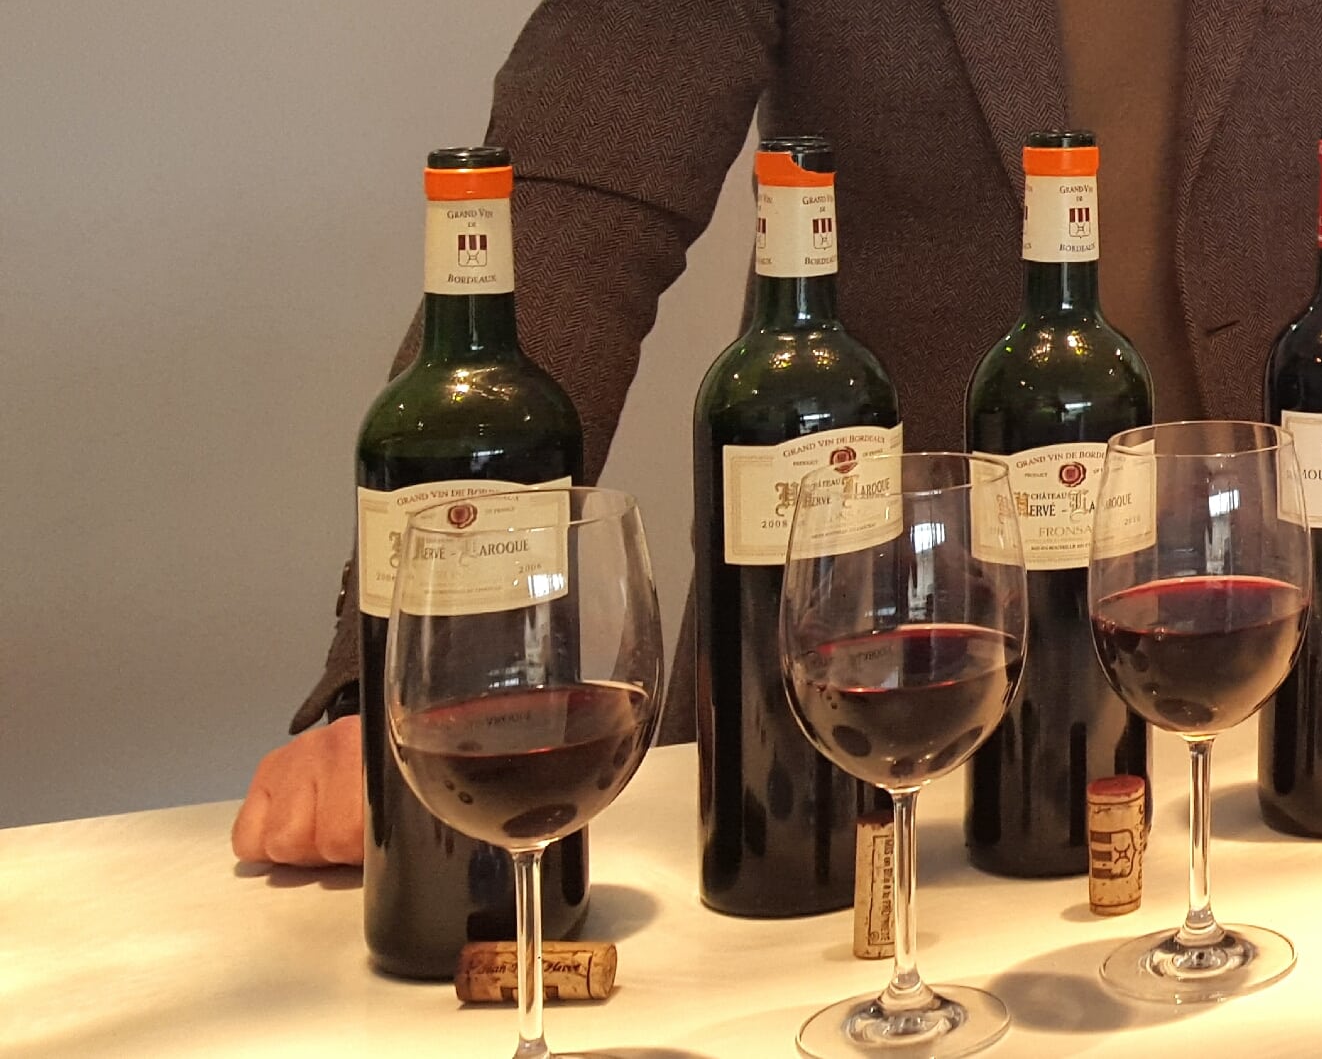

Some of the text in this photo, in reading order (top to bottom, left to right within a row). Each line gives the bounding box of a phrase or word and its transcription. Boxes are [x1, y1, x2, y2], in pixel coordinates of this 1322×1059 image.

[446, 209, 478, 219] GRAND
[783, 443, 816, 458] GRAND
[817, 438, 834, 447] VIN
[1015, 456, 1046, 469] GRAND
[1047, 452, 1064, 462] VIN
[1065, 451, 1076, 460] DE
[396, 494, 428, 506] GRAND
[1039, 525, 1093, 538] FRONSA
